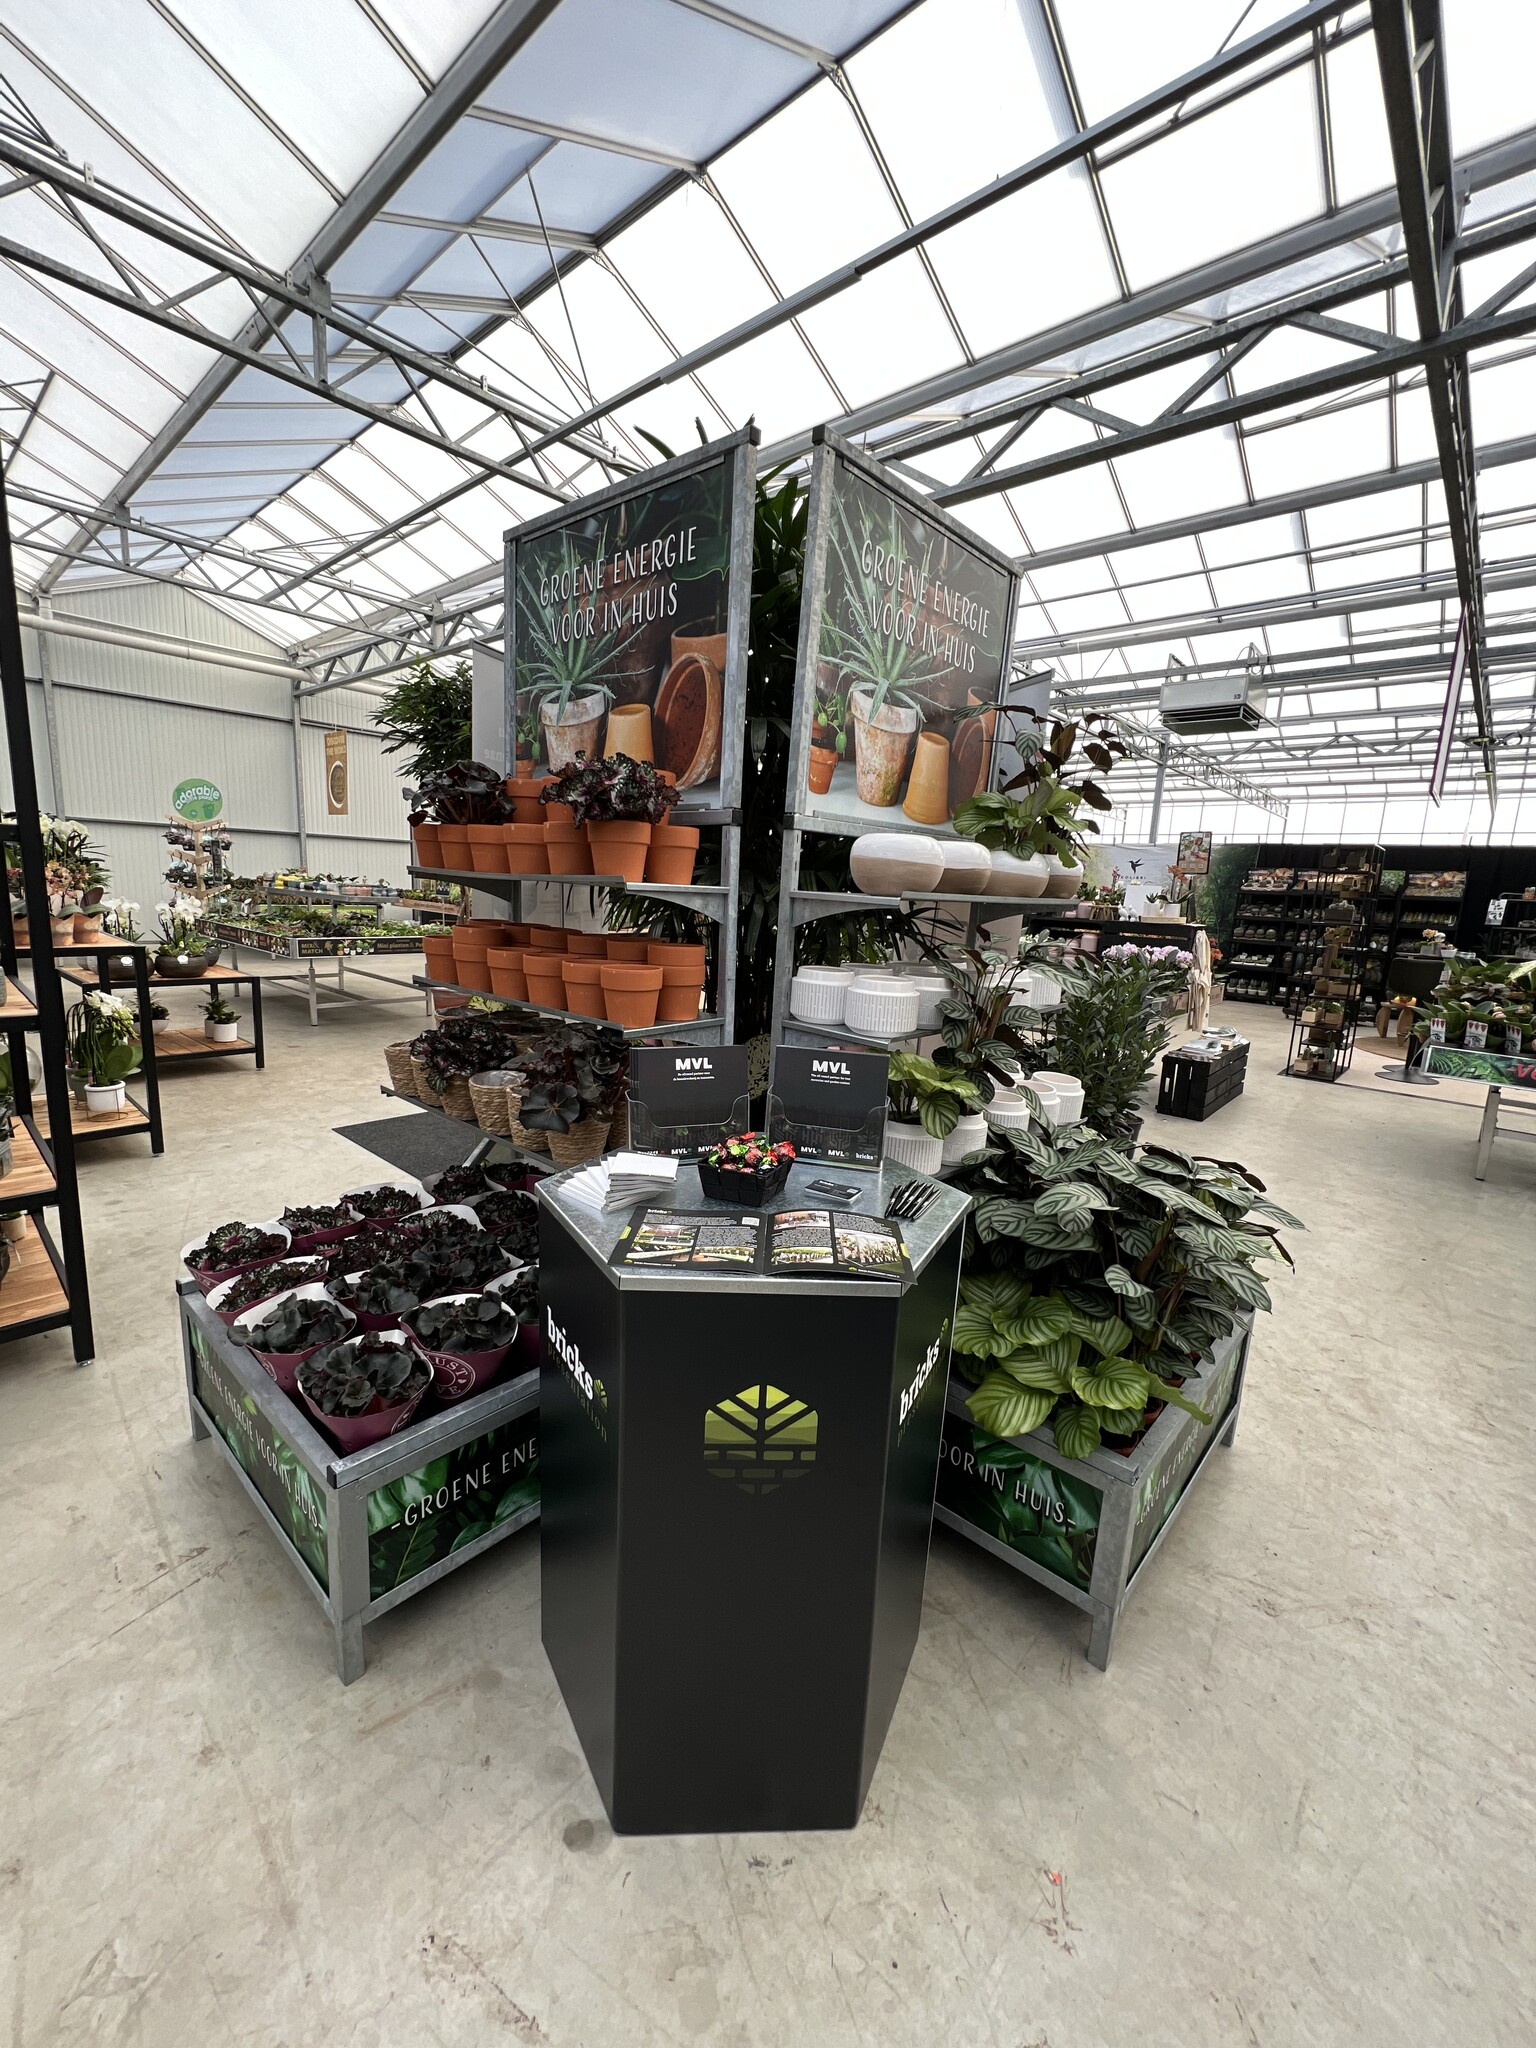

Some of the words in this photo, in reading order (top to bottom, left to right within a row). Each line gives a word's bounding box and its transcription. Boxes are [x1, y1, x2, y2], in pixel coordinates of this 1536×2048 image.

[540, 558, 605, 606] GROENE
[613, 526, 697, 584] ENERGIE
[861, 540, 928, 605] GROENE
[933, 580, 990, 638] ENERGIE
[551, 606, 595, 645] VOOR
[604, 599, 623, 632] IN
[632, 582, 678, 625] HUIS
[872, 595, 916, 647] VOOR
[922, 621, 939, 657] IN
[944, 632, 976, 673] HUIS
[175, 785, 220, 810] adorable
[675, 1057, 713, 1071] MVL
[812, 1059, 851, 1075] MVL
[800, 1146, 817, 1154] MVL
[827, 1149, 845, 1157] MVL
[855, 1152, 874, 1160] bricks
[547, 1304, 594, 1401] bricks
[899, 1337, 940, 1426] bricks
[255, 1428, 279, 1474] VOOR
[984, 1463, 1005, 1492] IN
